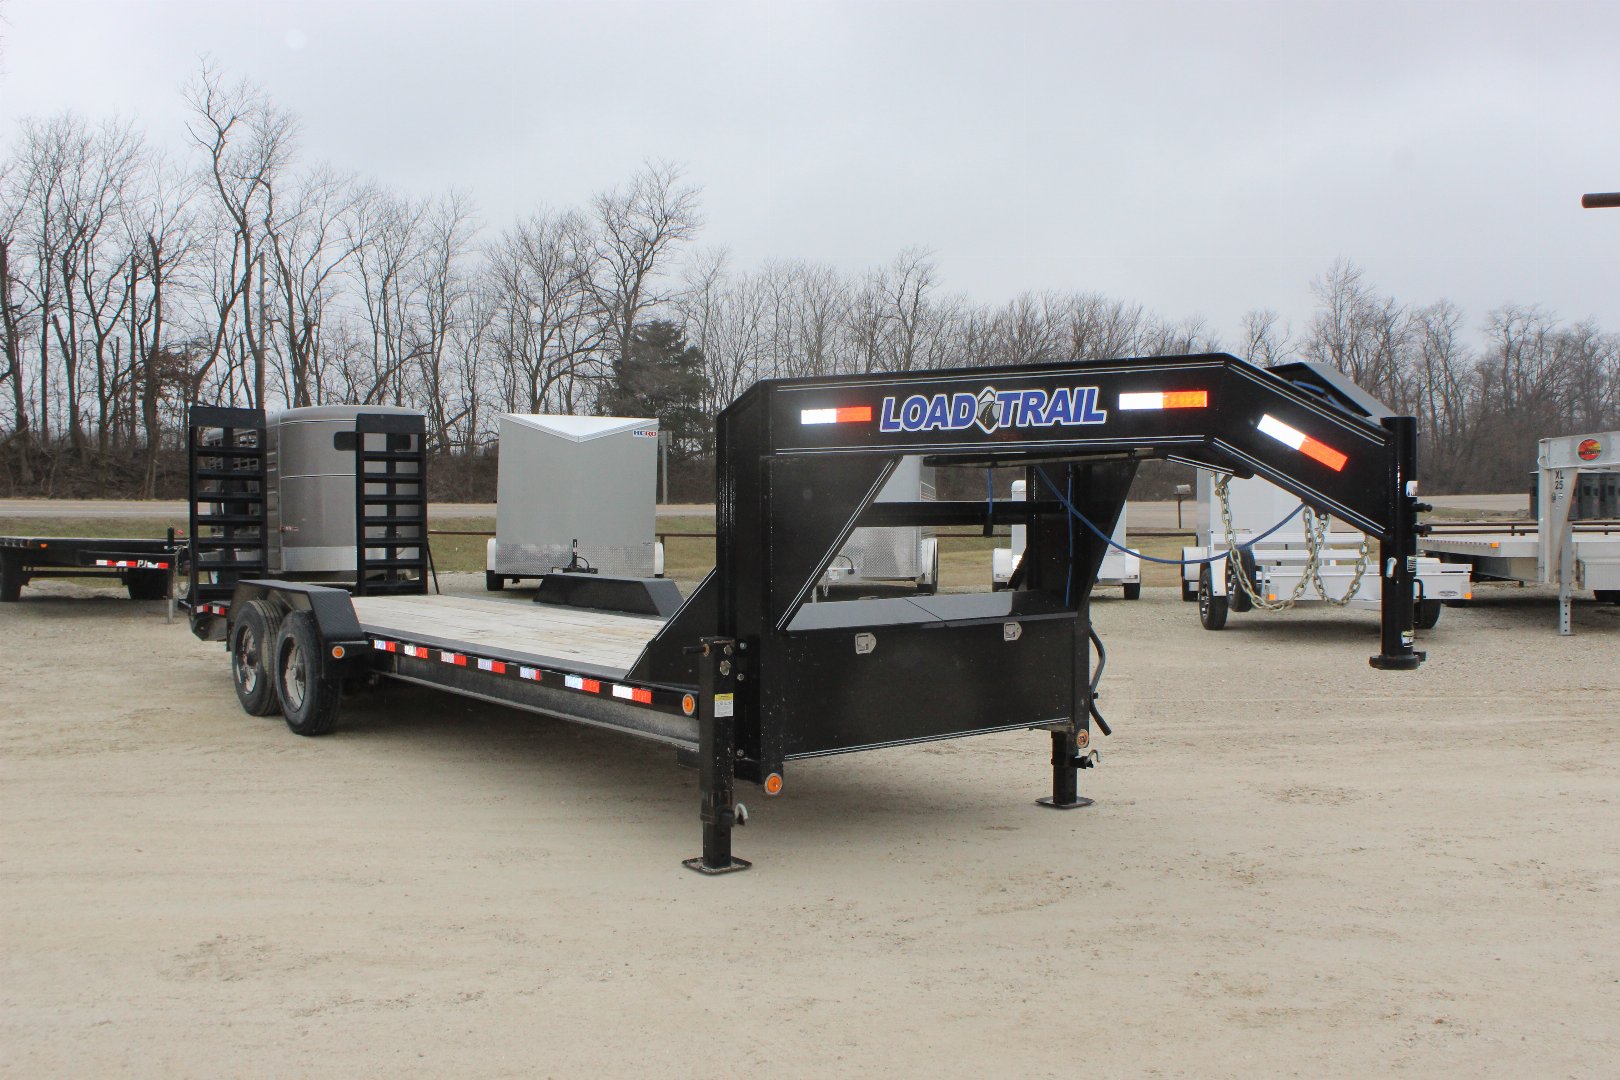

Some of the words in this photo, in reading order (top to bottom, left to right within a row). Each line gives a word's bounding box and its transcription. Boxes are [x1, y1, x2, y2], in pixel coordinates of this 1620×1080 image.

[880, 393, 978, 432] LOAD
[994, 387, 1107, 427] TRAIL
[1555, 470, 1564, 480] XL
[1555, 480, 1564, 490] 25
